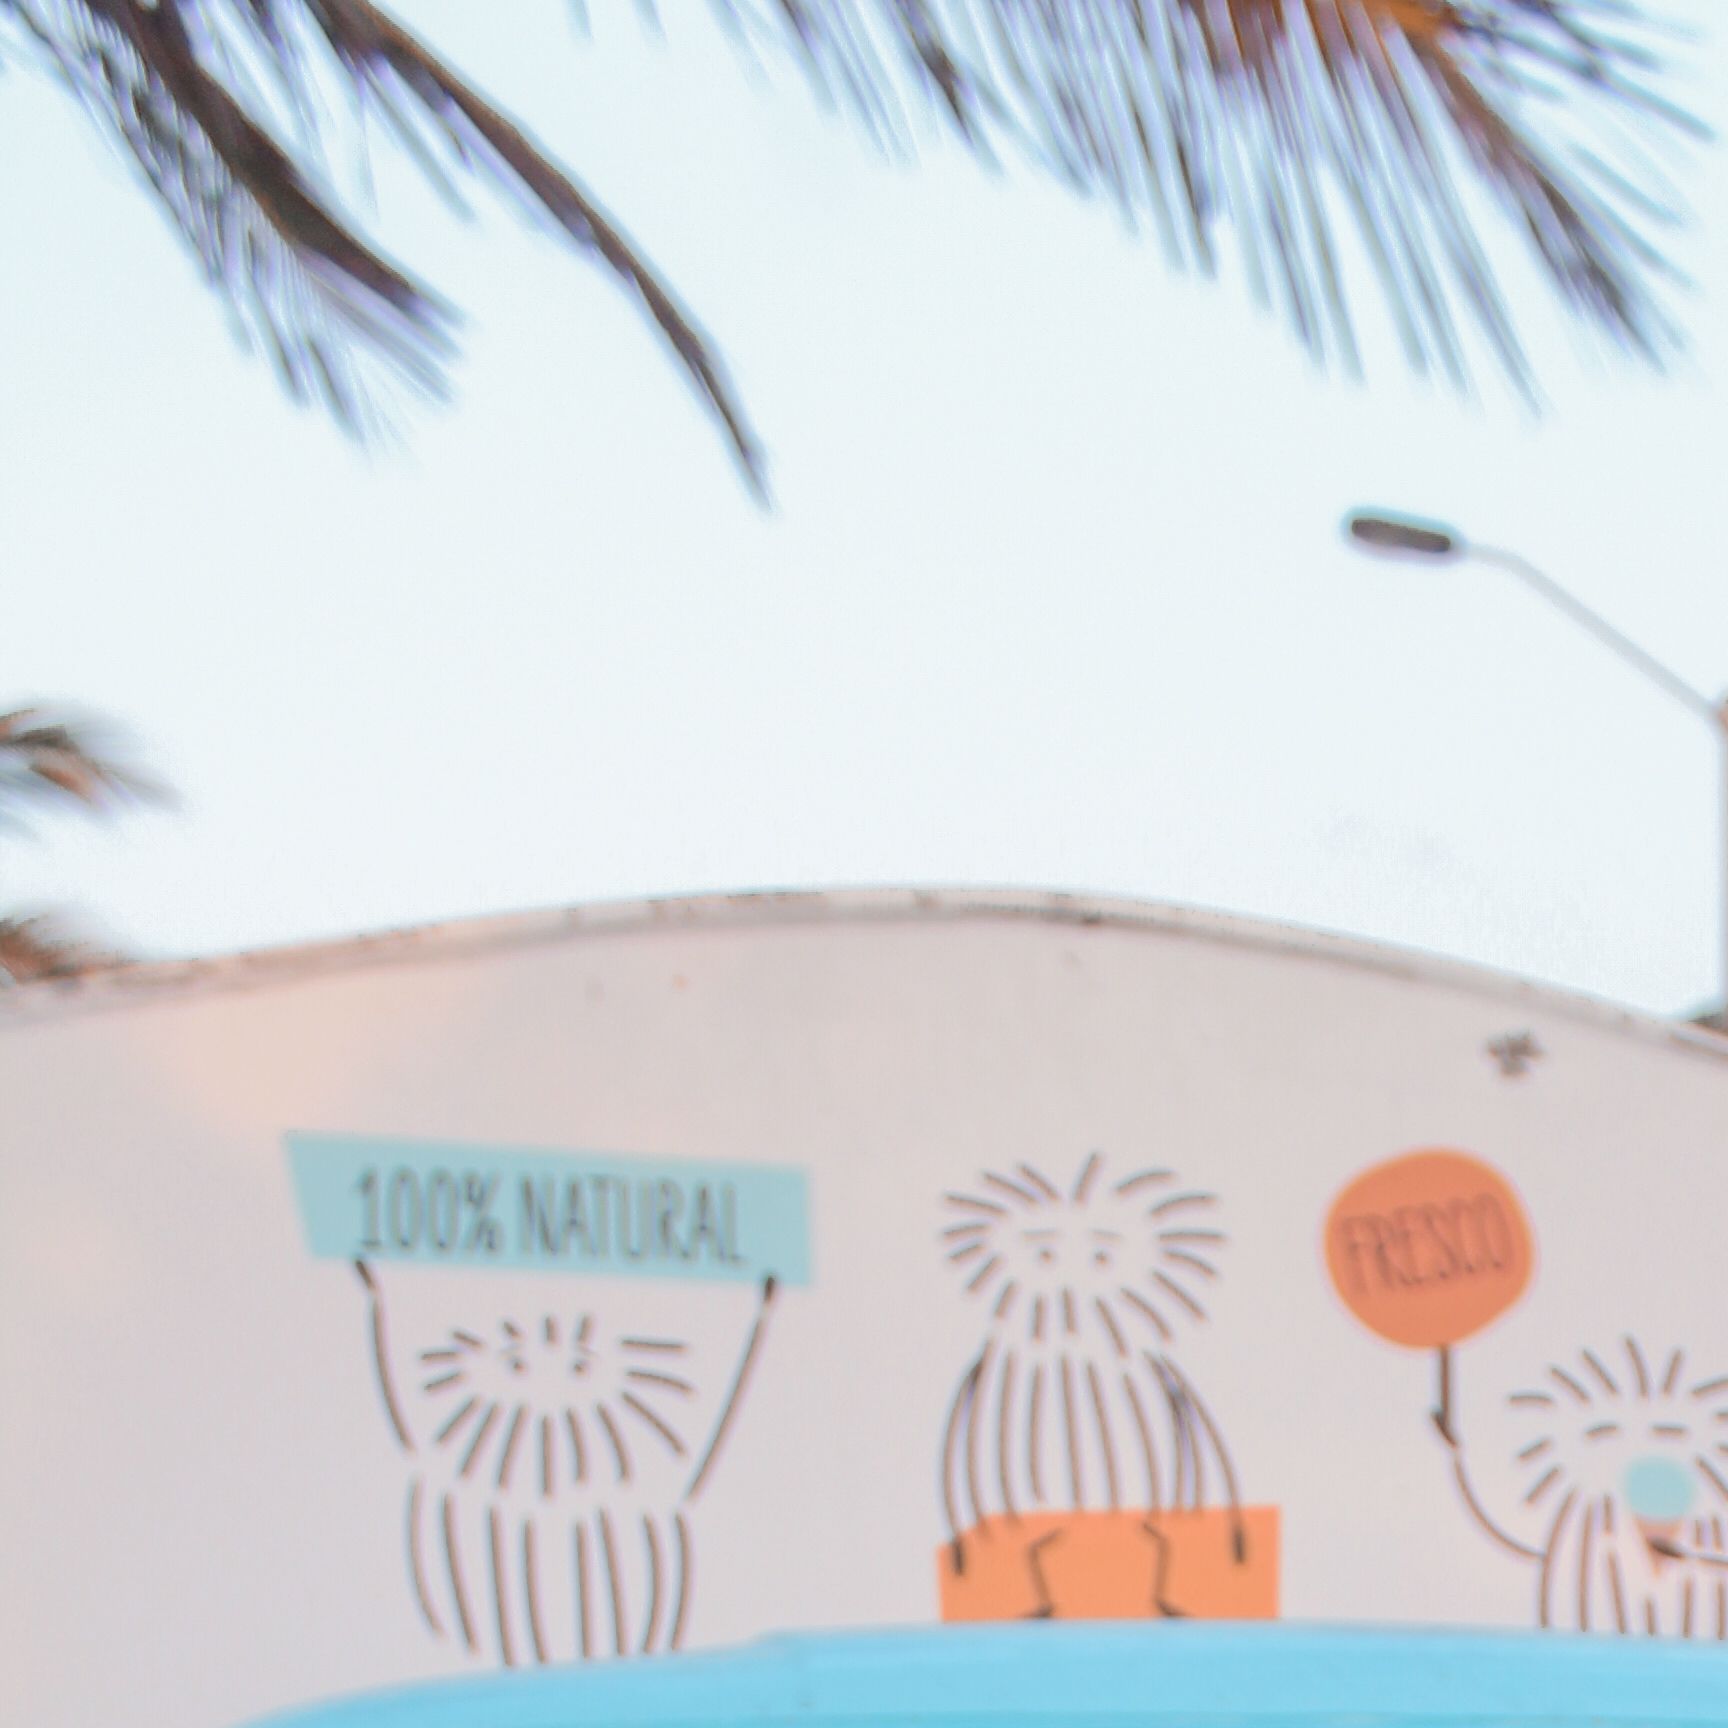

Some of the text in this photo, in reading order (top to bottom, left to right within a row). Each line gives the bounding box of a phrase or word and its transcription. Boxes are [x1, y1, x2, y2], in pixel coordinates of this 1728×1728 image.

[352, 1167, 748, 1267] 100% NATURAL
[1341, 1193, 1514, 1297] FRESCO
